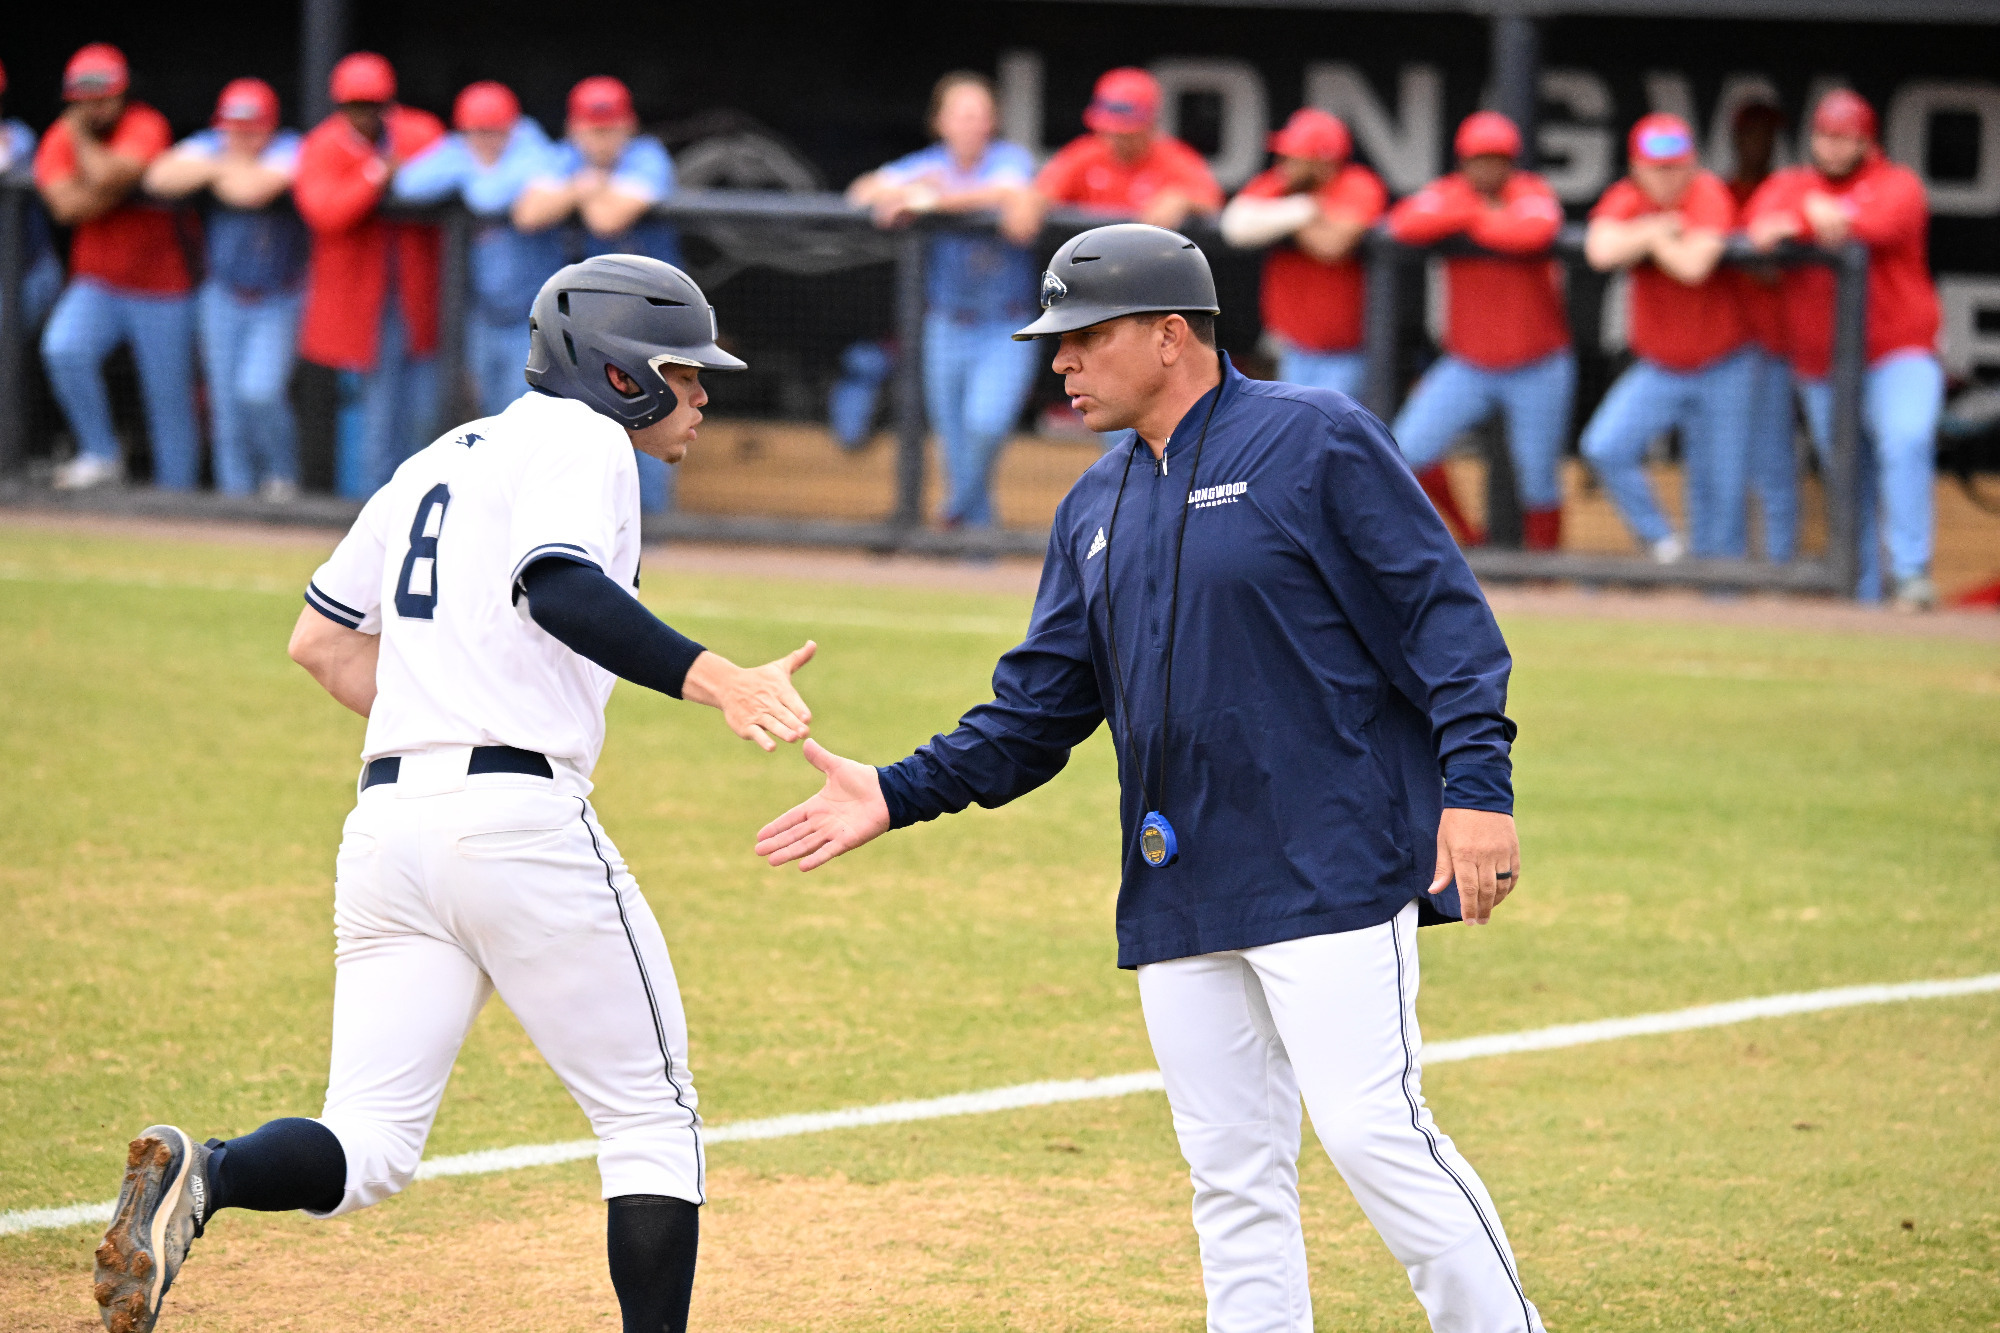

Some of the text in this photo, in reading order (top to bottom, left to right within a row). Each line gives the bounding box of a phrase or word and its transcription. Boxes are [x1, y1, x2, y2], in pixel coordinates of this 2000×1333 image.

[1187, 481, 1248, 504] LONGWOOD
[1195, 496, 1239, 510] BASEBALL
[394, 479, 453, 622] 8
